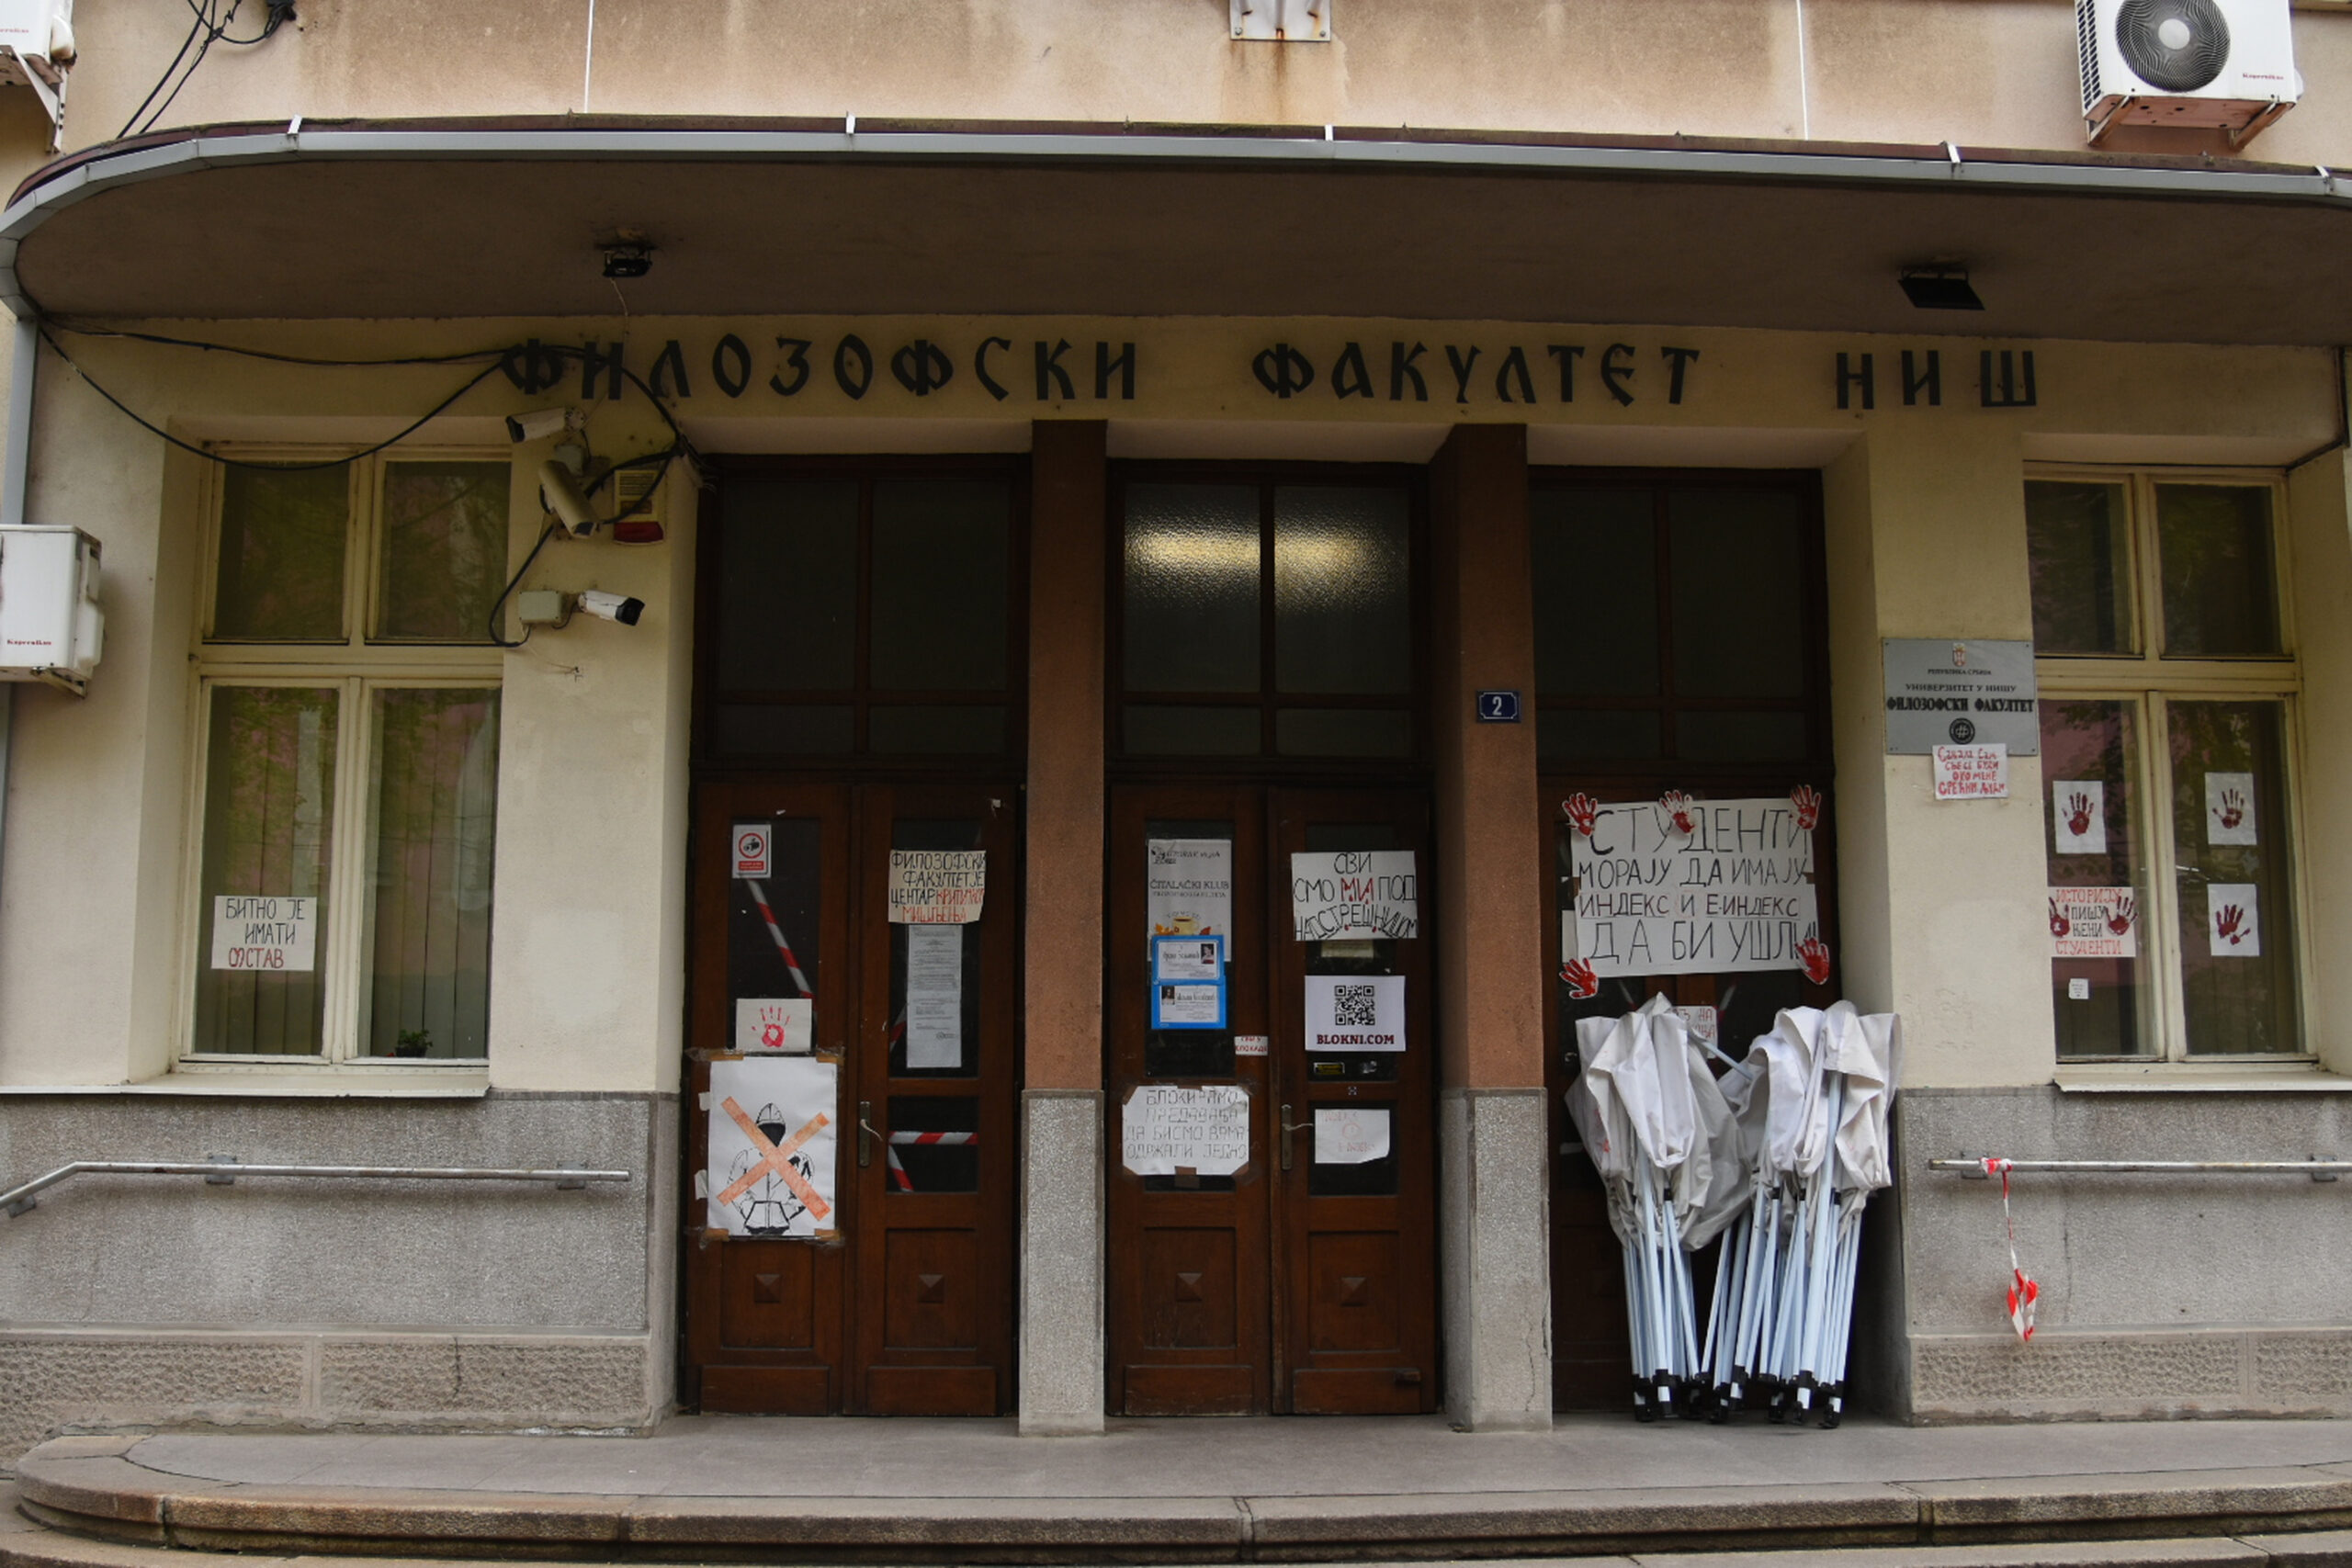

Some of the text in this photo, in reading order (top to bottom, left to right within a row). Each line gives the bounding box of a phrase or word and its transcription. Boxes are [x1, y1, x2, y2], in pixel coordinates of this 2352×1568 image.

[501, 333, 1136, 401] ФИЛОЗОФСКИ
[1837, 348, 2037, 410] НИШ
[1905, 683, 1973, 692] УНИВЕРЗИТЕТ
[1492, 696, 1502, 716] 2
[1887, 696, 2035, 713] ФИЛОЗОФСКИ ФАКУЛТЕТ
[1590, 807, 1808, 856] СТУДЕНТИ
[891, 852, 986, 871] ФИЛОЗОФСКИ
[1334, 852, 1372, 874] СВИ
[902, 871, 970, 887] ФАКУЛТЕТ
[1578, 857, 1808, 889] МОРАЈУ ДА ИМАЈУ
[1204, 881, 1229, 889] KLUB
[1294, 874, 1417, 903] СМО МИ ПОД
[891, 888, 935, 908] ЦЕНТАР
[1578, 893, 1669, 917] ИНДЕКС
[1680, 894, 1695, 917] И
[226, 897, 305, 919] БИТНО ЈЕ
[2071, 906, 2106, 919] ПИШУ
[244, 922, 296, 945] ИМАТИ
[1589, 919, 1652, 964] ДА
[1672, 920, 1713, 961] БИ
[2055, 939, 2122, 955] СТУДЕНТИ
[1317, 1034, 1395, 1044] BLOKNI.COM
[1147, 1089, 1238, 1105] БЛОКИРАМО
[1125, 1125, 1146, 1141] ДА
[1153, 1125, 1204, 1141] БИСМО
[1125, 1144, 1193, 1159] ОДРЖАЛИ
